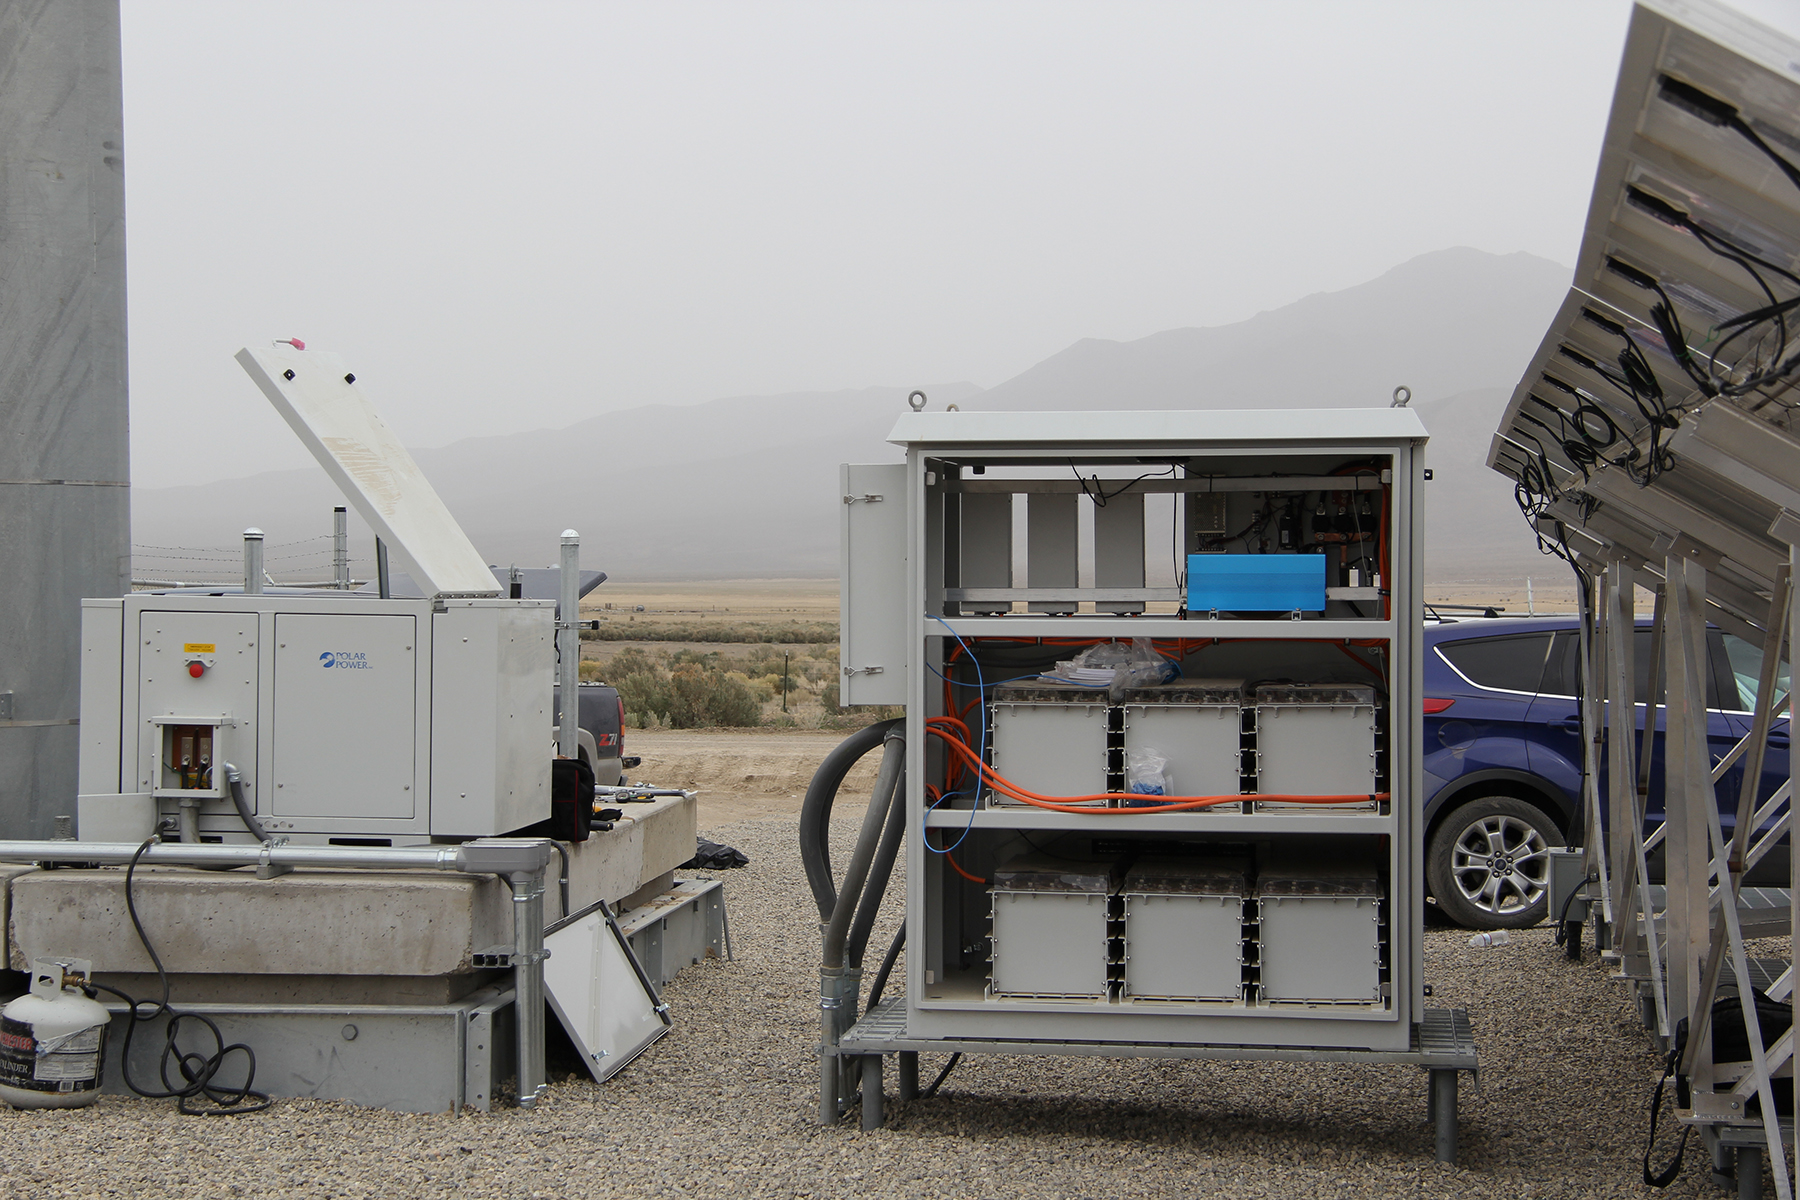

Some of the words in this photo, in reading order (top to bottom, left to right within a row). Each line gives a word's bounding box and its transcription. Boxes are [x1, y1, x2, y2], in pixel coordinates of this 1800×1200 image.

[336, 652, 366, 660] POLAR
[336, 661, 368, 669] POWER
[599, 733, 617, 746] Z71
